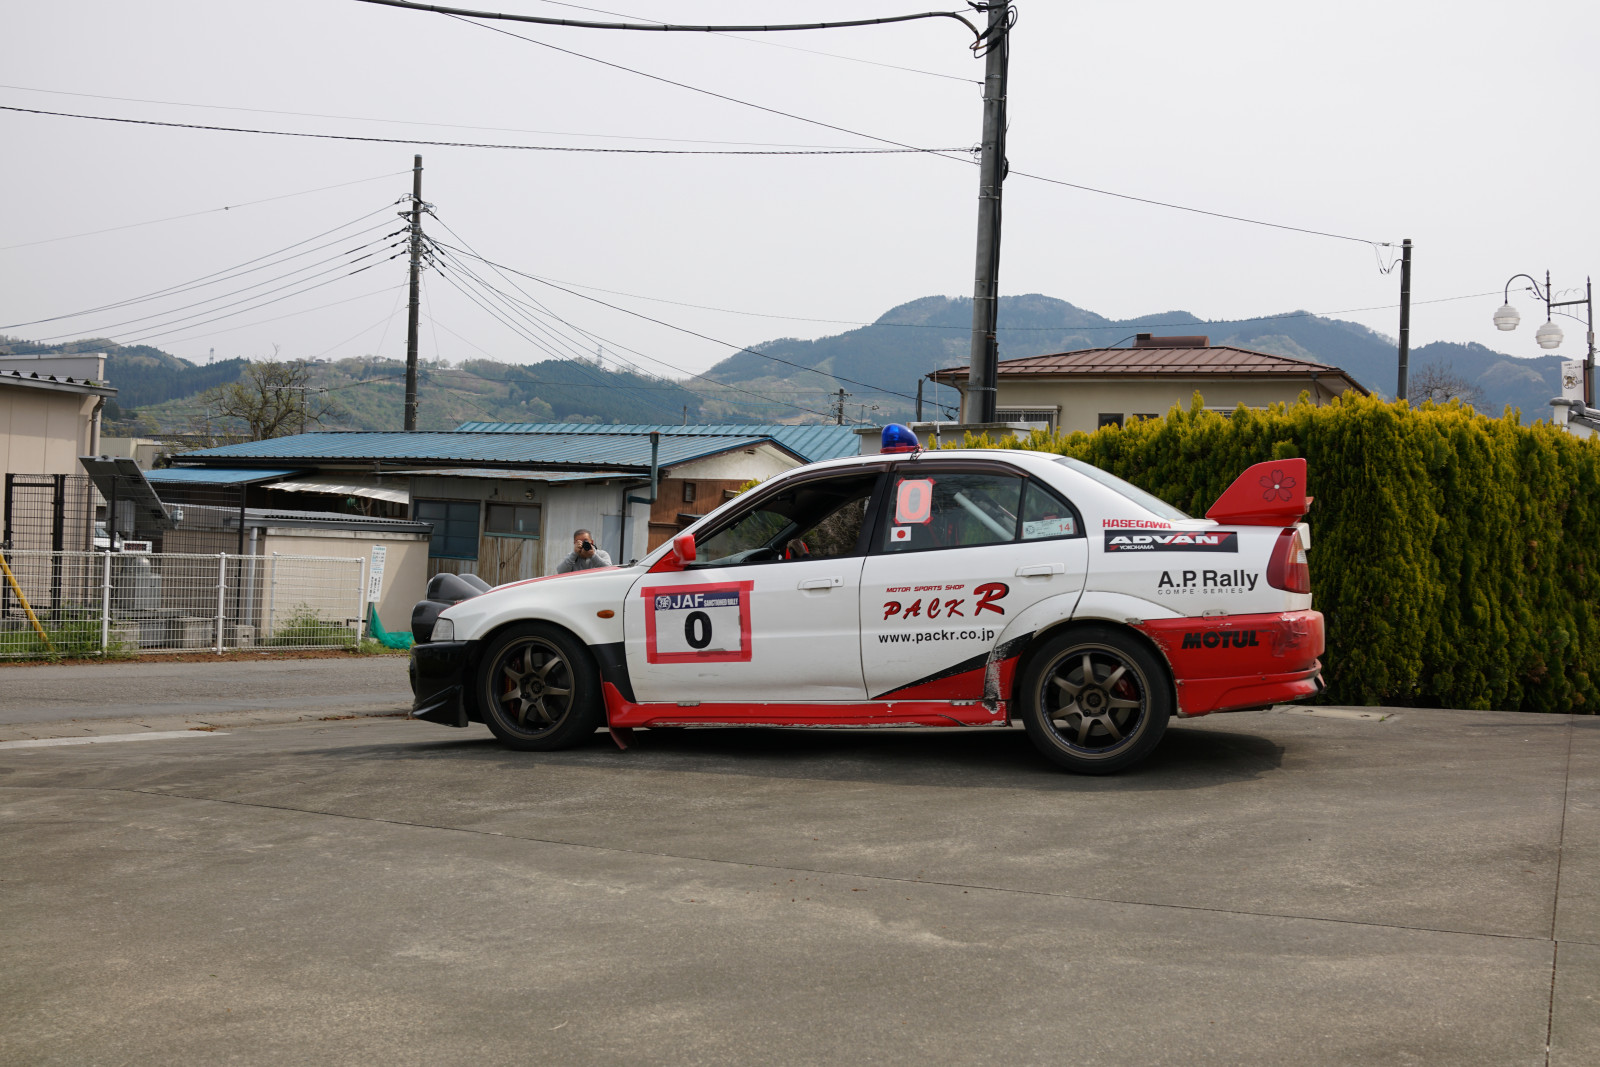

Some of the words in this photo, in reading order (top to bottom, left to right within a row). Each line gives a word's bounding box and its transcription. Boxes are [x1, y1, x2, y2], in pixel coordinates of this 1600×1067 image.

[899, 481, 930, 520] 0
[1058, 522, 1071, 532] 14
[1102, 519, 1172, 529] HASEGAWA
[1108, 535, 1219, 545] ADVAN
[1158, 570, 1197, 588] A.P.
[1202, 569, 1259, 591] Rally
[672, 593, 705, 609] JAF
[883, 598, 965, 620] PACK
[973, 582, 1010, 617] R
[684, 610, 713, 650] 0
[878, 627, 995, 645] www.packr.co.jp
[1181, 630, 1260, 649] MOTUL
